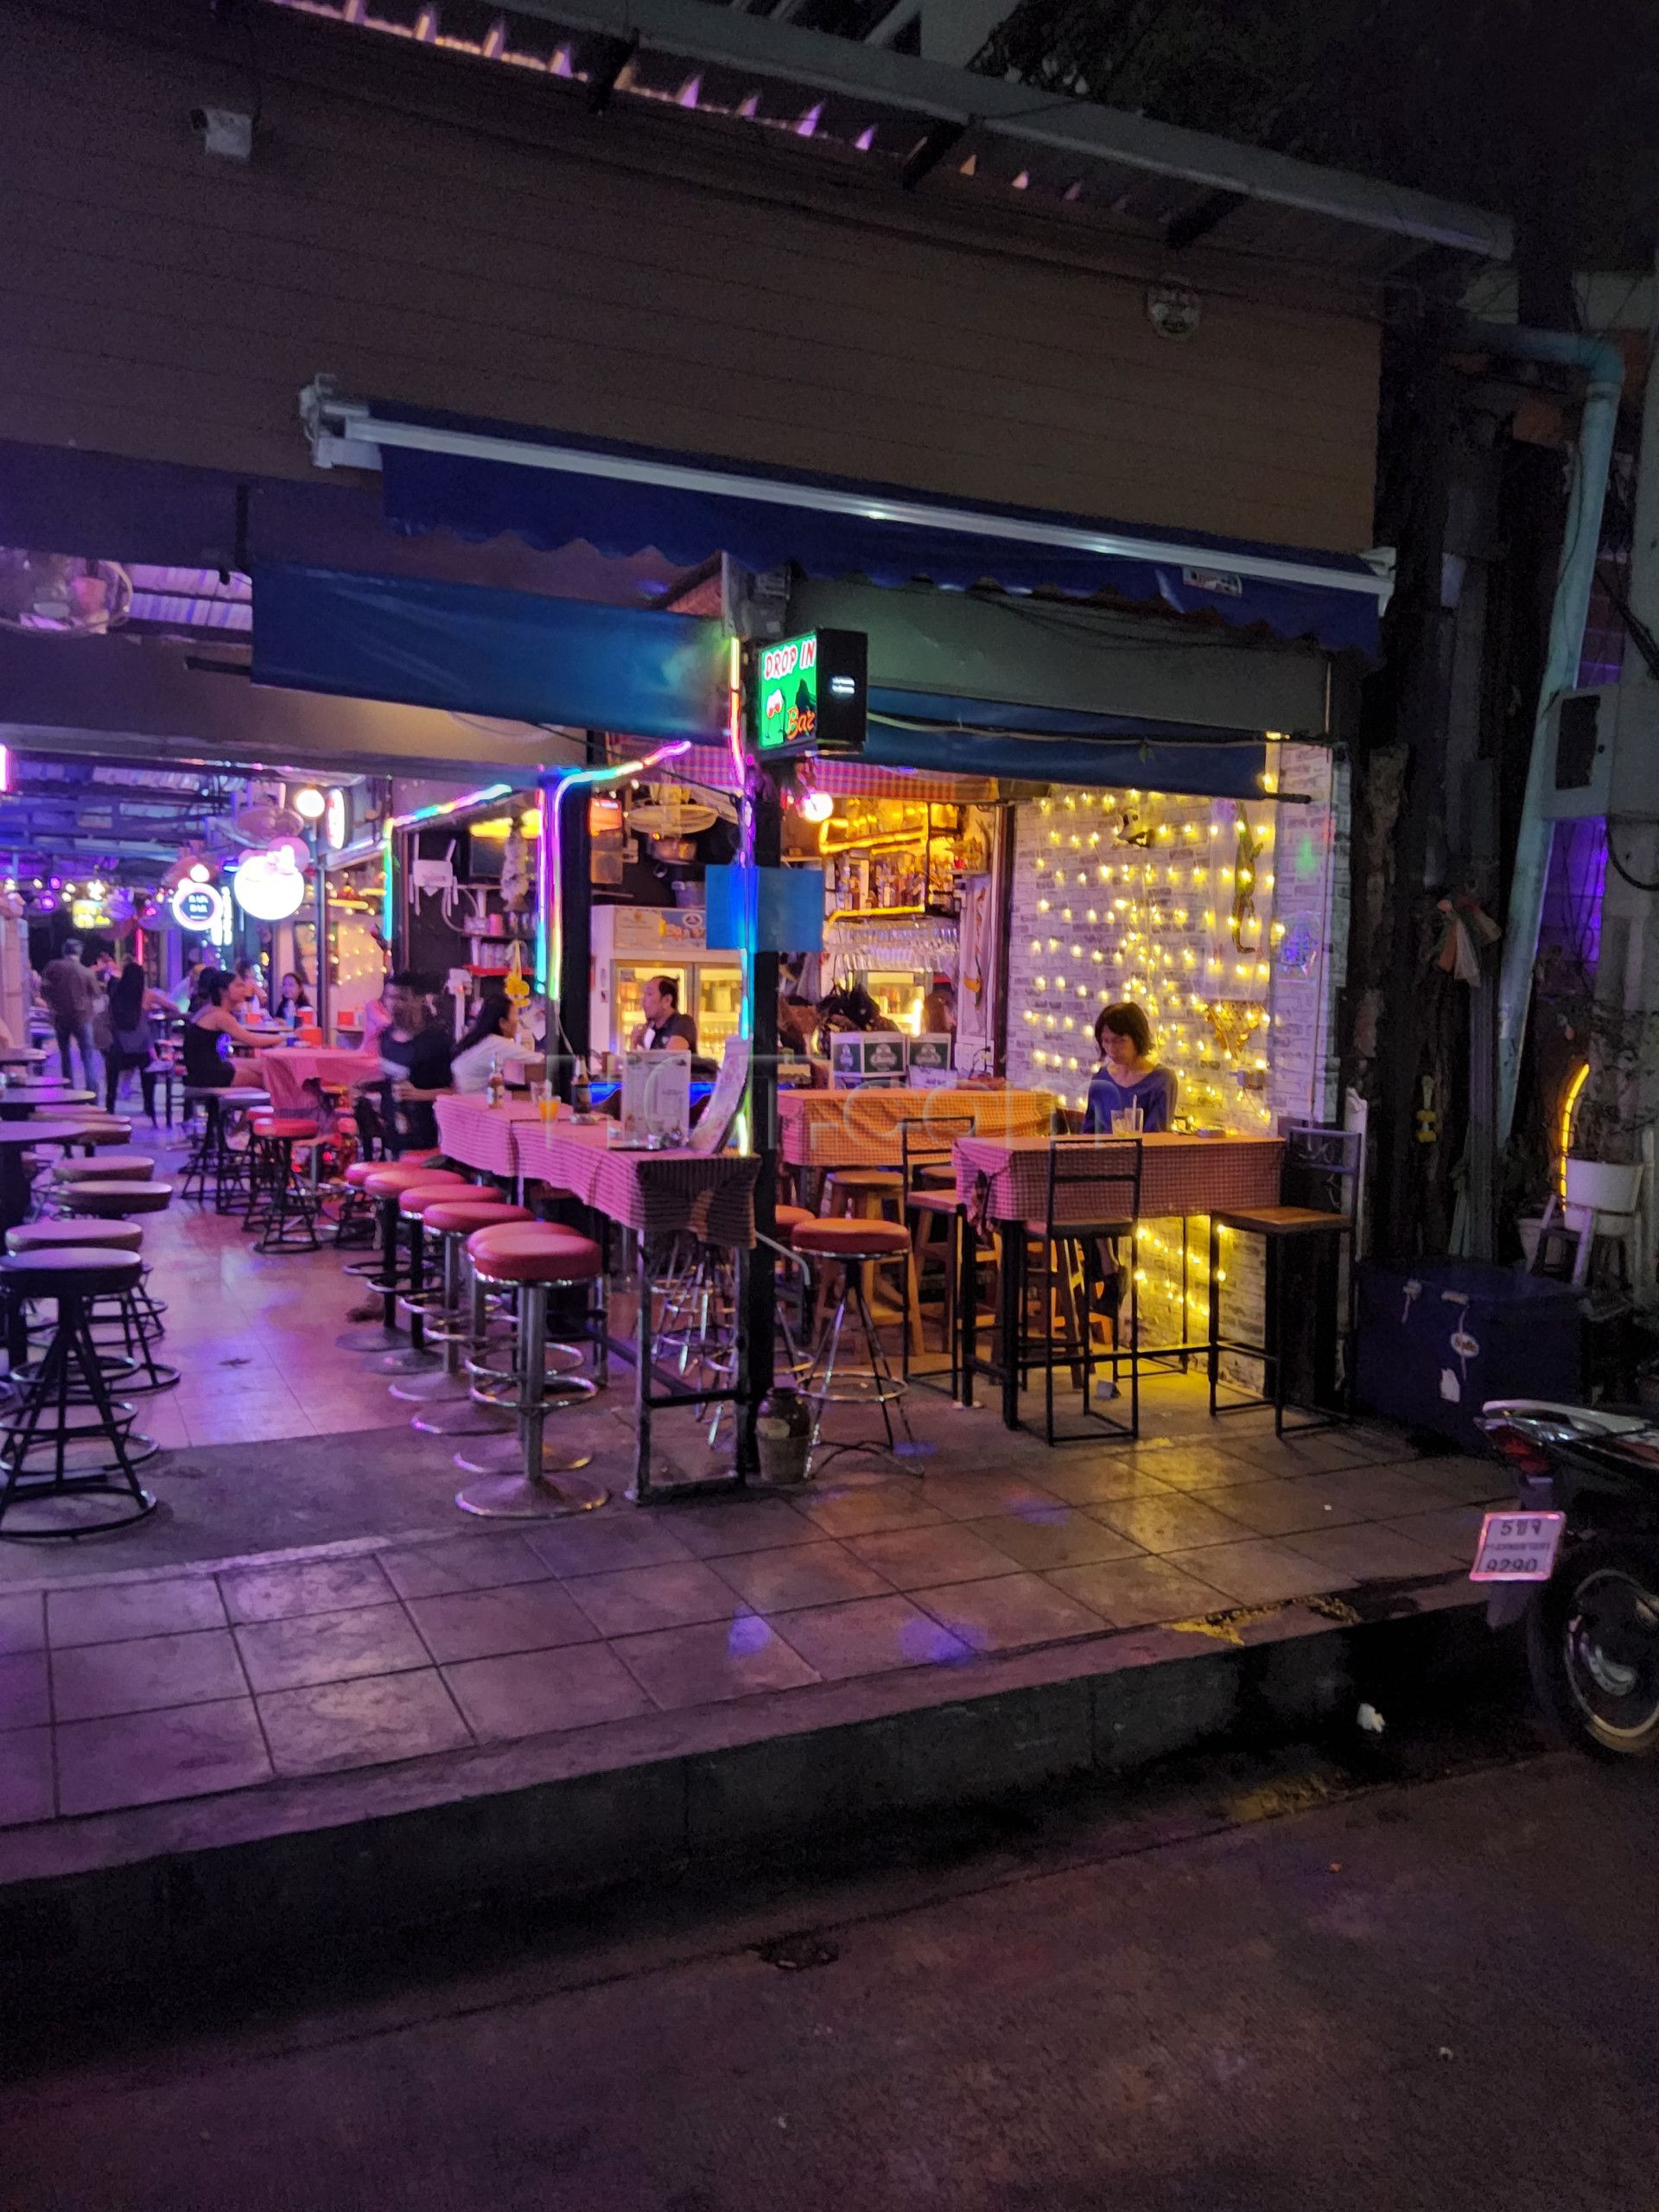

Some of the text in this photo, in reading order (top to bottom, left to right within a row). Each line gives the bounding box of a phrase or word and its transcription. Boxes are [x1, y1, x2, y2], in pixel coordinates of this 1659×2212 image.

[765, 639, 817, 680] DROP IN
[787, 707, 816, 741] Bar
